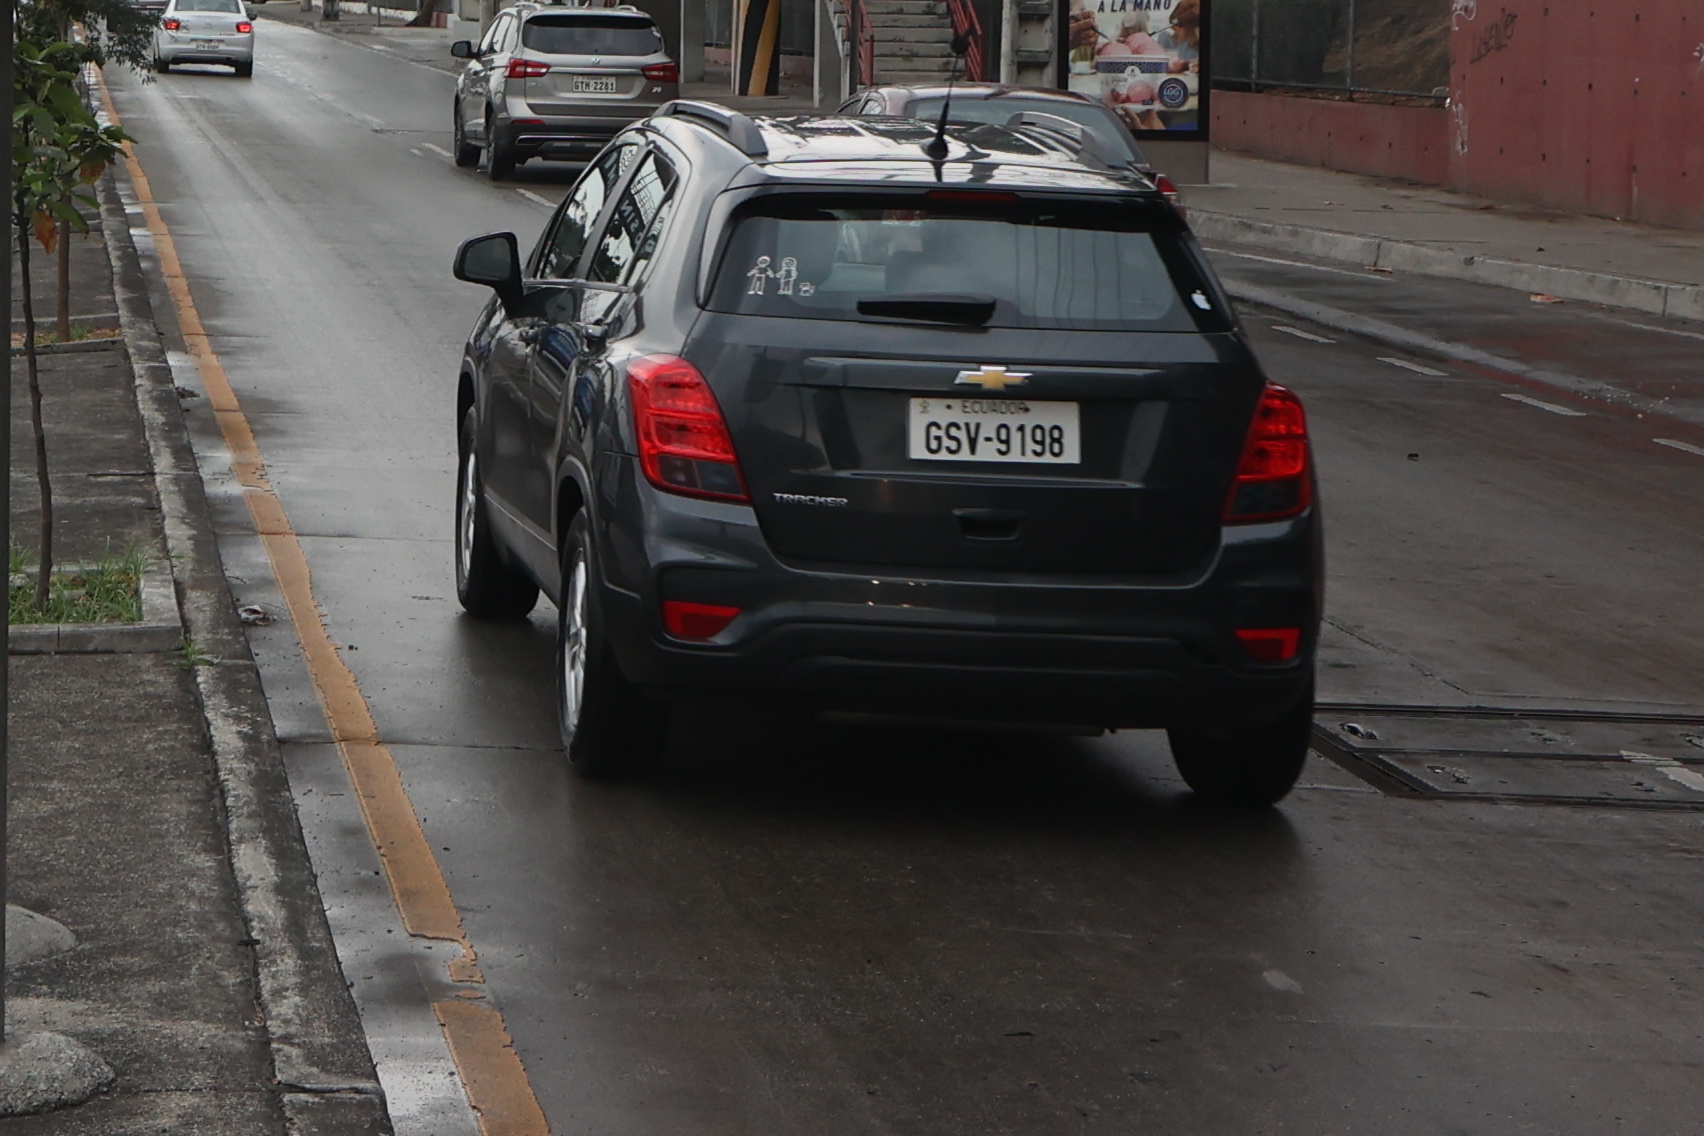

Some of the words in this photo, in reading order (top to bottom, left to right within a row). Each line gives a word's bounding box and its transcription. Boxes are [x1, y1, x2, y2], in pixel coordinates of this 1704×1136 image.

[1097, 0, 1105, 13] A
[1110, 0, 1127, 13] LA
[961, 400, 1027, 415] ECUADOR
[925, 421, 1065, 458] GSV-9198
[772, 492, 848, 507] TRACKER
